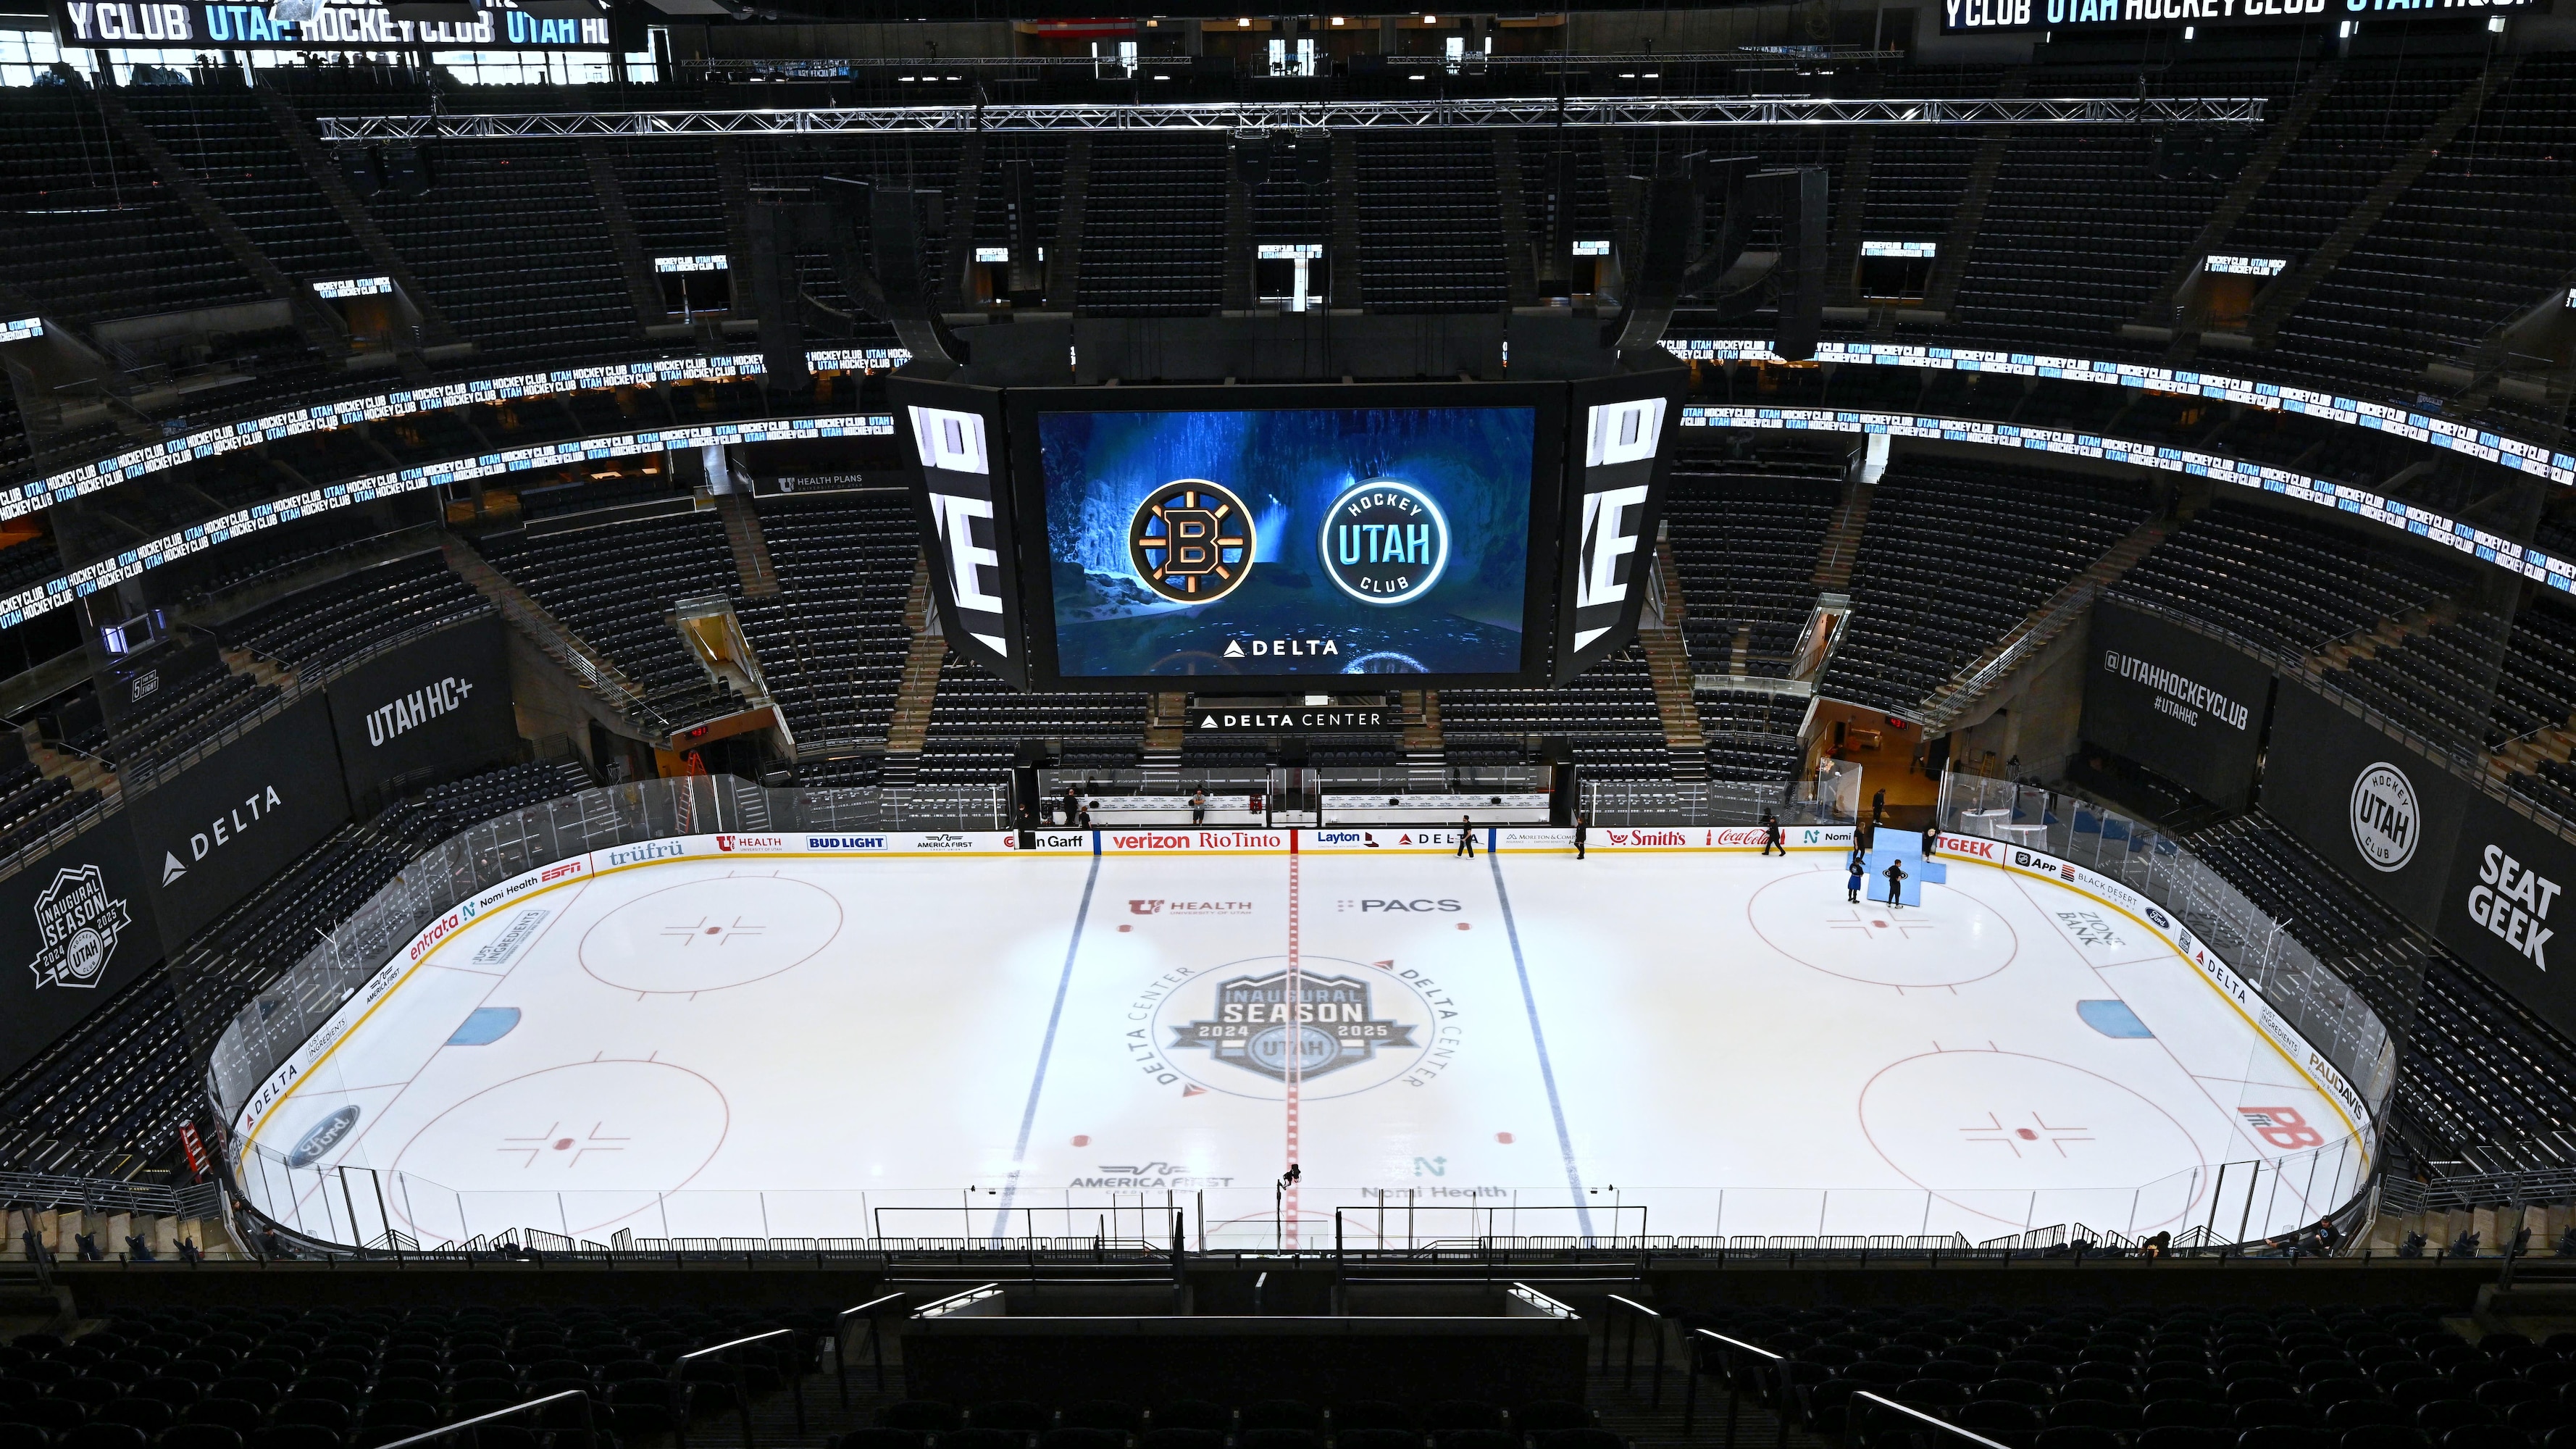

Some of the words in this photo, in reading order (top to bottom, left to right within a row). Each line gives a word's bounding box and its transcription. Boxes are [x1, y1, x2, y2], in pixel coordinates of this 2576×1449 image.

[96, 3, 190, 40] CLUB
[1965, 0, 2031, 26] CLUB
[356, 278, 373, 288] UTAH
[573, 367, 605, 379] HOCKEY
[606, 365, 627, 376] CLUB
[631, 362, 653, 373] UTAH
[653, 359, 685, 372] HOCKEY
[686, 358, 707, 369] CLUB
[711, 356, 732, 367] UTAH
[2175, 370, 2199, 384] UTAH
[2199, 374, 2231, 389] HOCKEY
[2230, 378, 2253, 392] CLUB
[2255, 383, 2280, 396] UTAH
[2279, 386, 2311, 402] HOCKEY
[2310, 392, 2332, 406] CLUB
[236, 420, 259, 435] UTAH
[258, 414, 288, 430] HOCKEY
[288, 409, 308, 424] CLUB
[311, 404, 334, 419] UTAH
[334, 399, 364, 415] HOCKEY
[365, 395, 386, 409] CLUB
[1683, 407, 1703, 417] UTAH
[1704, 408, 1734, 418] HOCKEY
[1734, 408, 1755, 418] CLUB
[1759, 409, 1781, 419] UTAH
[1781, 410, 1812, 420] HOCKEY
[1812, 412, 1834, 422] CLUB
[798, 477, 831, 485] HEALTH
[834, 475, 862, 483] PLANS
[1347, 493, 1422, 517] HOCKEY
[1164, 509, 1218, 575] B
[1339, 524, 1429, 565] UTAH
[2454, 522, 2475, 540] UTAH
[2474, 529, 2504, 551] HOCKEY
[2501, 539, 2522, 558] CLUB
[46, 577, 69, 596] UTAH
[68, 564, 97, 587] HOCKEY
[96, 557, 117, 575] CLUB
[1360, 576, 1409, 593] CLUB
[1253, 640, 1339, 656] DELTA
[142, 681, 156, 695] FIGHT
[2104, 650, 2249, 731] @UTAHHOCKEYCLUB
[366, 690, 427, 747] UTAH
[426, 677, 473, 719] HC+
[1224, 715, 1293, 727] DELTA
[1302, 714, 1380, 725] CENTER
[2154, 696, 2198, 727] #UTAHHC
[2372, 774, 2409, 807] HOCKEY
[190, 785, 282, 861] DELTA
[2360, 788, 2409, 851] UTAH
[739, 838, 782, 846] HEALTH
[809, 838, 840, 848] BUD
[842, 838, 884, 848] LIGHT
[1047, 835, 1083, 848] Garff
[1113, 832, 1190, 849] verizon
[1318, 832, 1360, 844] Layton
[1631, 830, 1686, 845] Smith's
[2365, 838, 2390, 860] CLUB
[609, 840, 685, 867] trüfrü
[541, 862, 581, 882] ESPN
[2480, 844, 2562, 921] SEAT
[41, 880, 100, 926] INAUGURAL
[480, 890, 505, 909] Nomi
[506, 877, 538, 895] Health
[2078, 873, 2105, 890] BLACK
[2107, 885, 2137, 906] DESERT
[46, 892, 105, 946] SEASON
[1361, 899, 1462, 912] PACS
[2149, 910, 2166, 927] Ford
[97, 909, 117, 930] 2025
[2056, 912, 2103, 948] BANK
[2079, 911, 2126, 946] ZIONS
[2467, 885, 2554, 972] GEEK
[73, 933, 93, 949] HOCKEY
[411, 914, 459, 961] entrata
[485, 912, 539, 961] INGREDIENTS
[43, 945, 65, 967] 2024
[72, 940, 99, 968] UTAH
[83, 961, 96, 973] CLUB
[367, 981, 388, 1005] AMERICA
[387, 967, 400, 985] FIRST
[1128, 967, 1195, 1021] CENTER
[1400, 969, 1458, 1019] DELTA
[2207, 959, 2246, 1004] DELTA
[1226, 990, 1360, 1002] INAUGURAL
[1224, 1003, 1363, 1022] SEASON
[2262, 1005, 2275, 1019] JUST
[307, 1035, 319, 1050] JUST
[309, 1018, 346, 1058] INGREDIENTS
[1199, 1026, 1248, 1037] 2024
[1339, 1026, 1387, 1036] 2025
[2262, 1014, 2298, 1052] INGREDIENTS
[1126, 1029, 1179, 1085] DELTA
[1263, 1041, 1323, 1056] UTAH
[1402, 1026, 1463, 1087] CENTER
[254, 1064, 297, 1115] DELTA
[301, 1117, 350, 1156] Ford
[1070, 1177, 1166, 1188] AMERICA
[1171, 1177, 1234, 1188] FIRST
[1362, 1186, 1423, 1199] Nomi
[1431, 1185, 1507, 1199] Health
